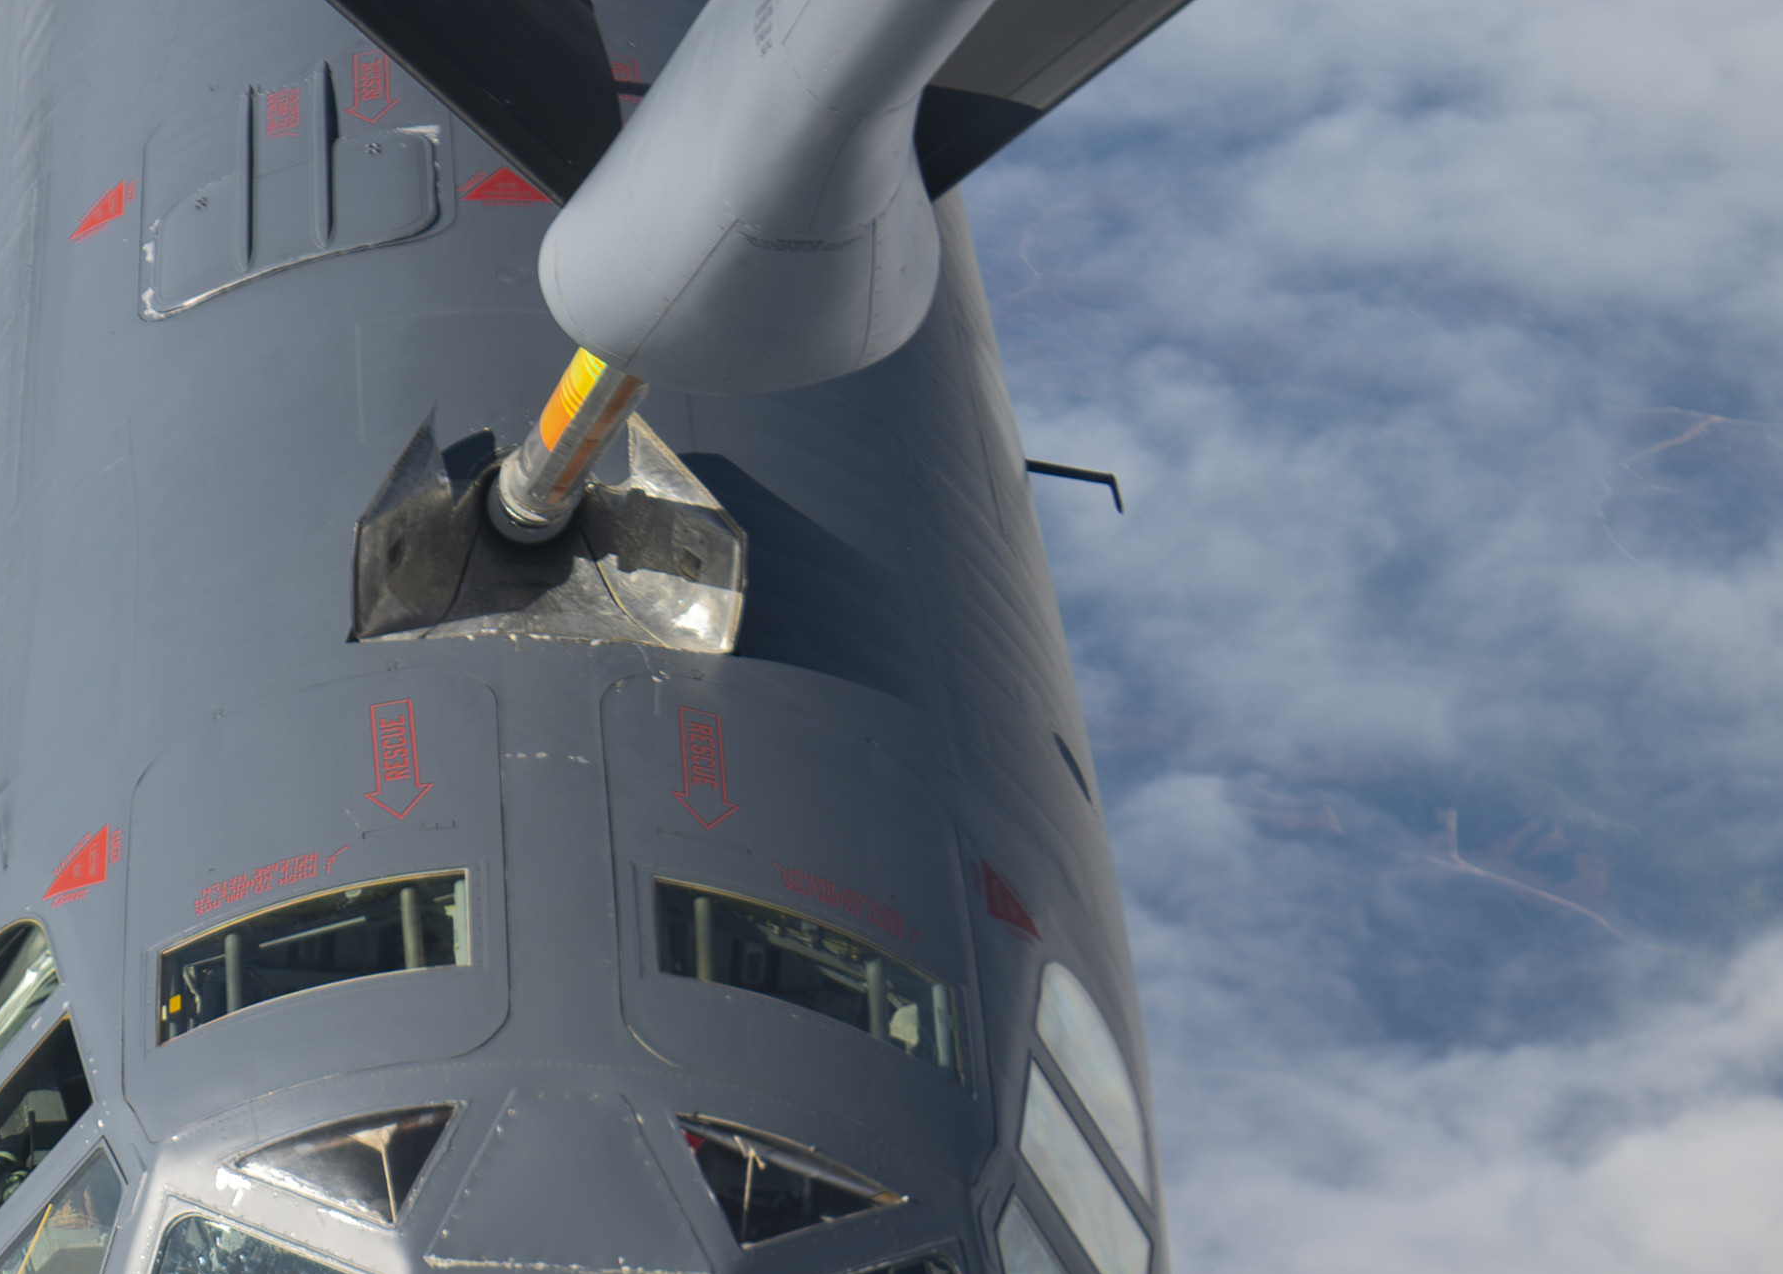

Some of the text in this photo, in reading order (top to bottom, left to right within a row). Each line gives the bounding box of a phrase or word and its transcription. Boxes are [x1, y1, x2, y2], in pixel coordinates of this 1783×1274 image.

[360, 58, 382, 101] RESCUE
[379, 713, 411, 782] RESCUE
[687, 720, 719, 791] RESCUE
[254, 880, 272, 894] TO
[278, 870, 317, 886] PUSH
